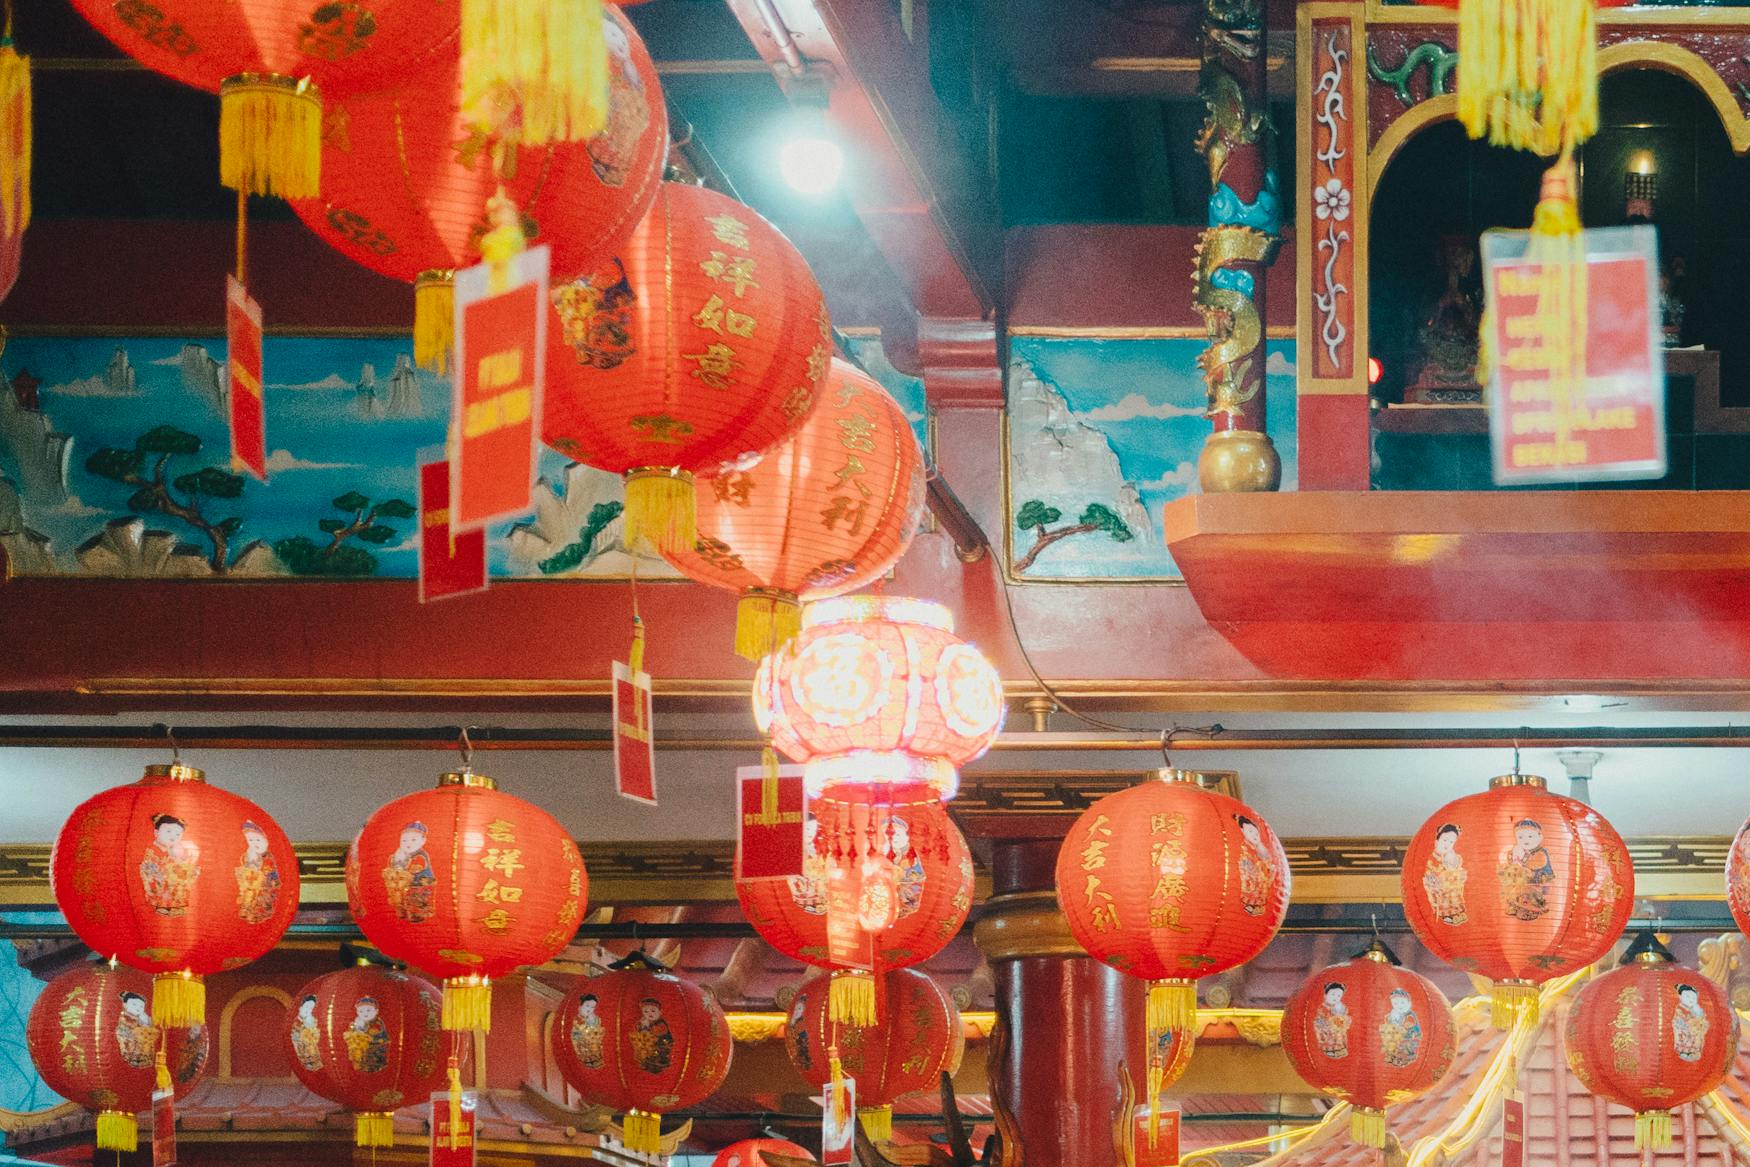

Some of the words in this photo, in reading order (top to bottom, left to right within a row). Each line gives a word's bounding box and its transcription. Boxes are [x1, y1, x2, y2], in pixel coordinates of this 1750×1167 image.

[681, 212, 760, 390] 吉祥如意
[474, 819, 526, 936] 吉祥如意
[1080, 814, 1121, 934] 大吉大利
